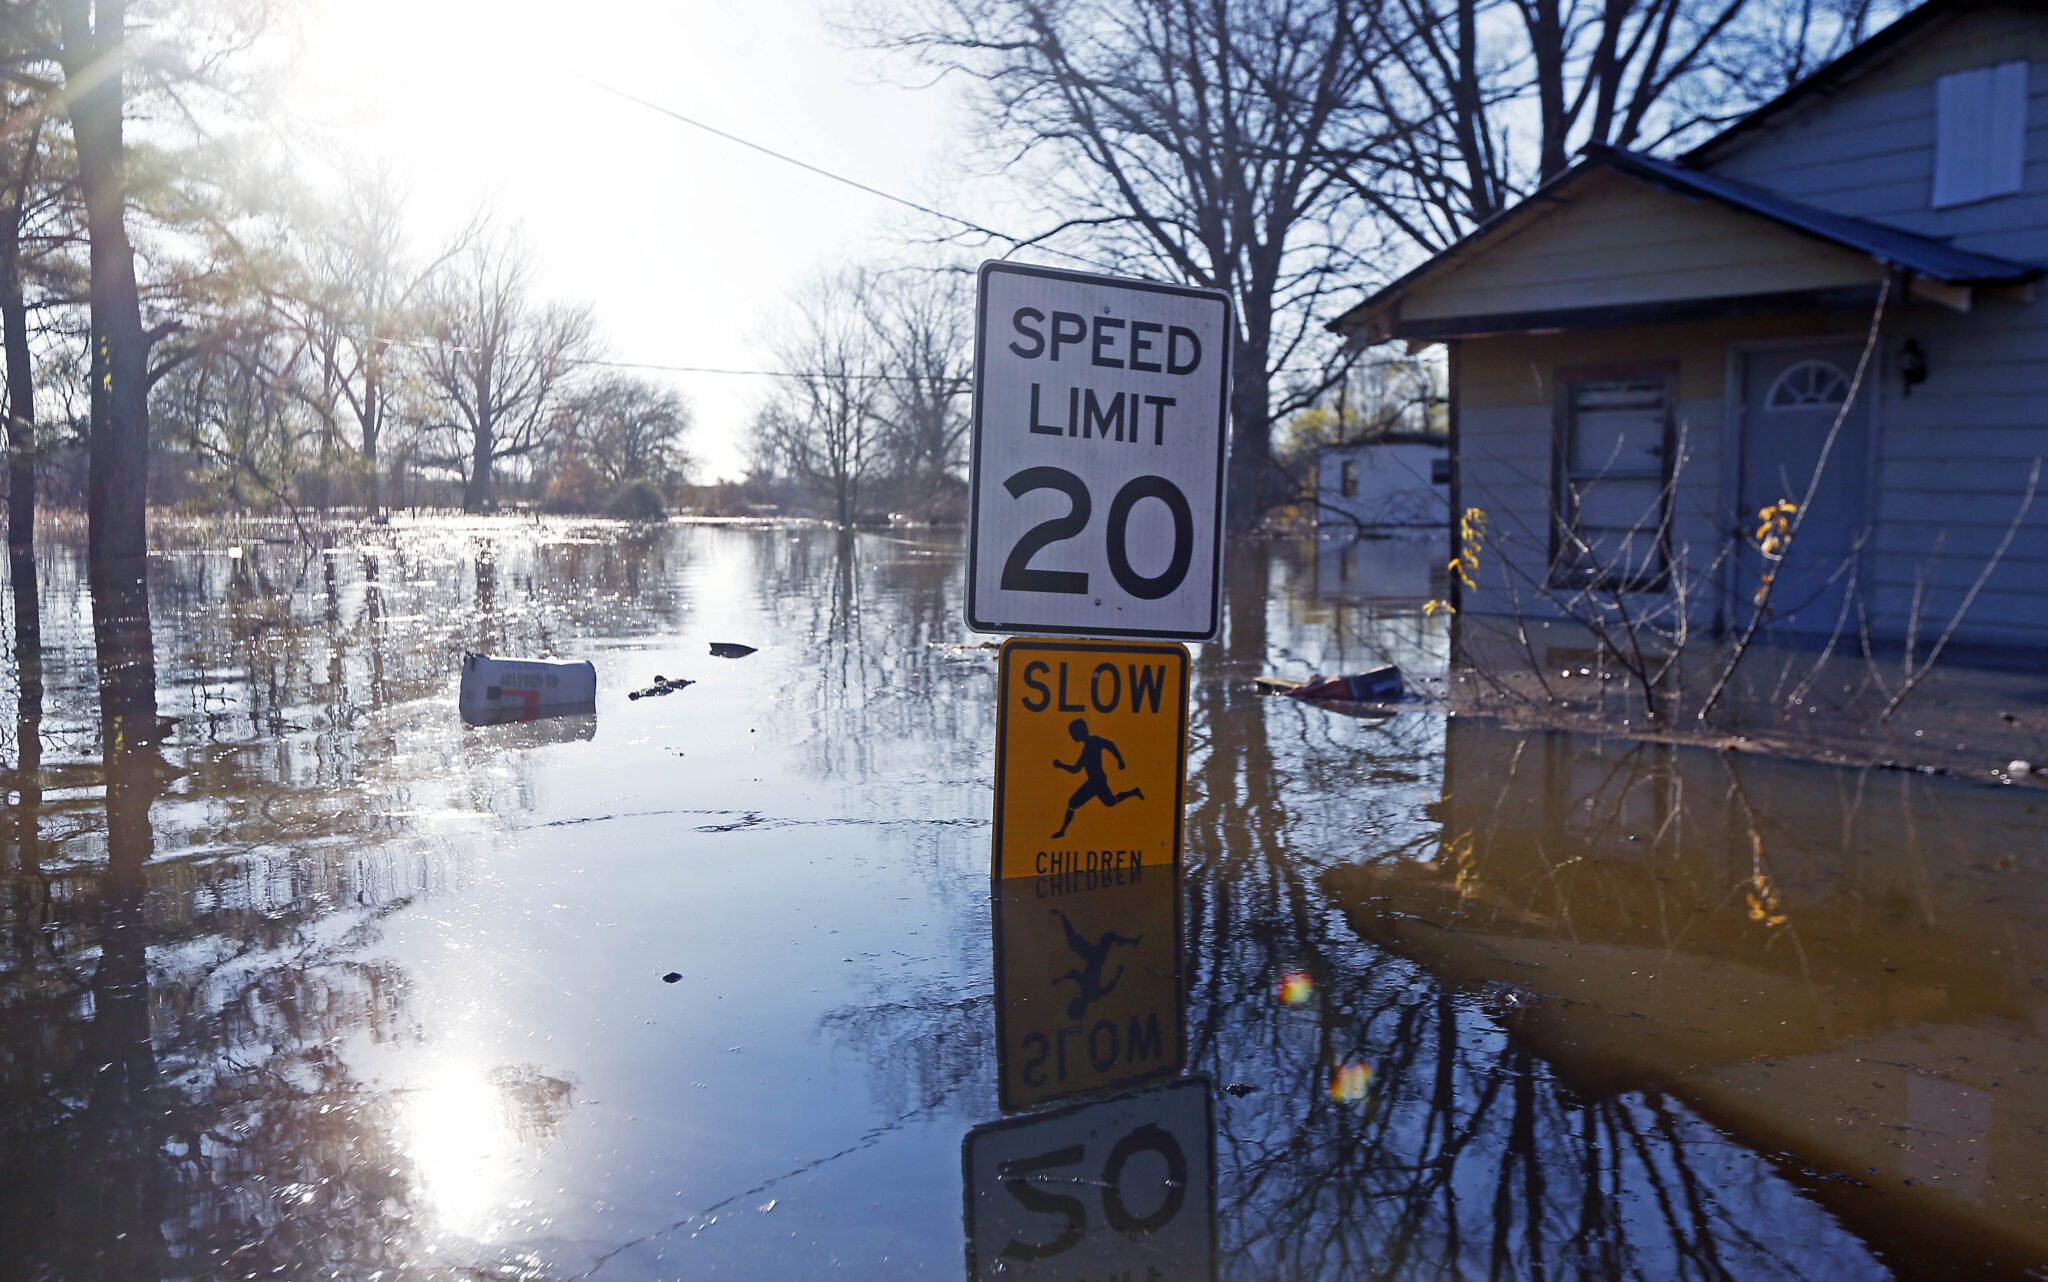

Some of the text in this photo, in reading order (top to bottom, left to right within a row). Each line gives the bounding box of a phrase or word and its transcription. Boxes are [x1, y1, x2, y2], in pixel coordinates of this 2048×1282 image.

[1008, 307, 1202, 376] SPEED
[1029, 383, 1176, 446] LIMIT
[1000, 465, 1194, 600] 20
[1021, 660, 1166, 714] SLOW
[1036, 850, 1142, 874] CHILDREN
